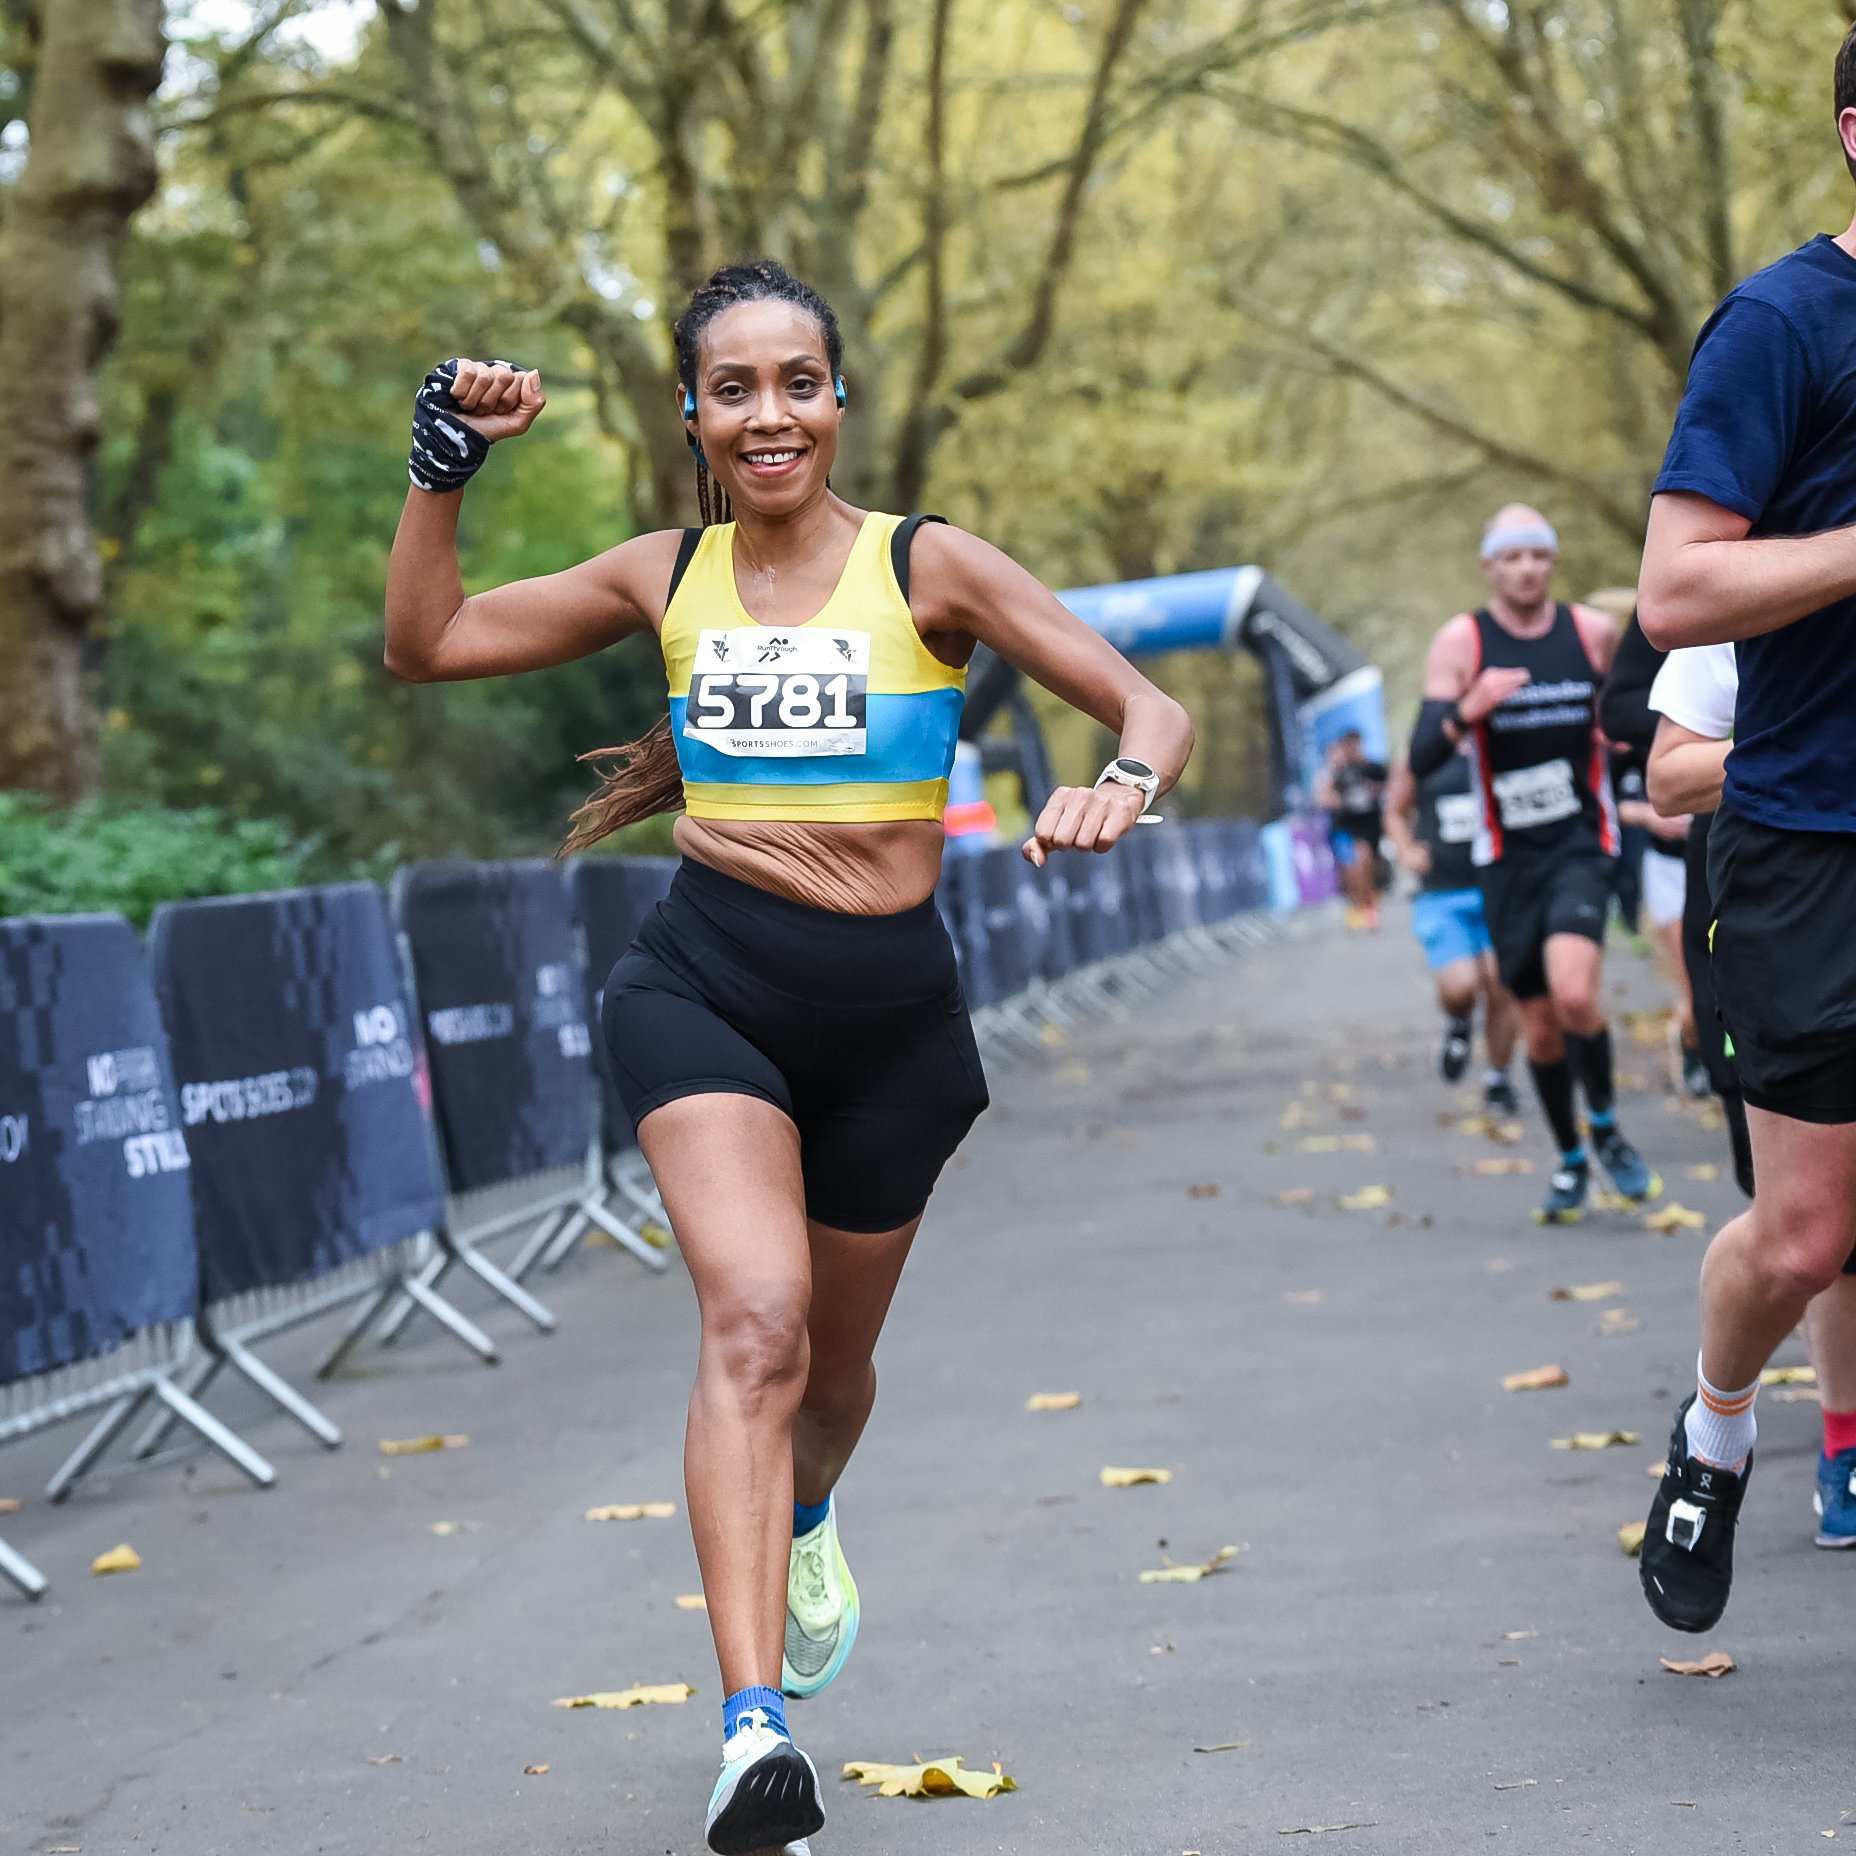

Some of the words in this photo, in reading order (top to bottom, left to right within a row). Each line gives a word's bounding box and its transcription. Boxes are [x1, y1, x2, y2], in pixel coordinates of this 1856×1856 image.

[757, 645, 798, 653] RunThrough
[697, 674, 857, 728] 5781
[353, 1005, 397, 1047] NO
